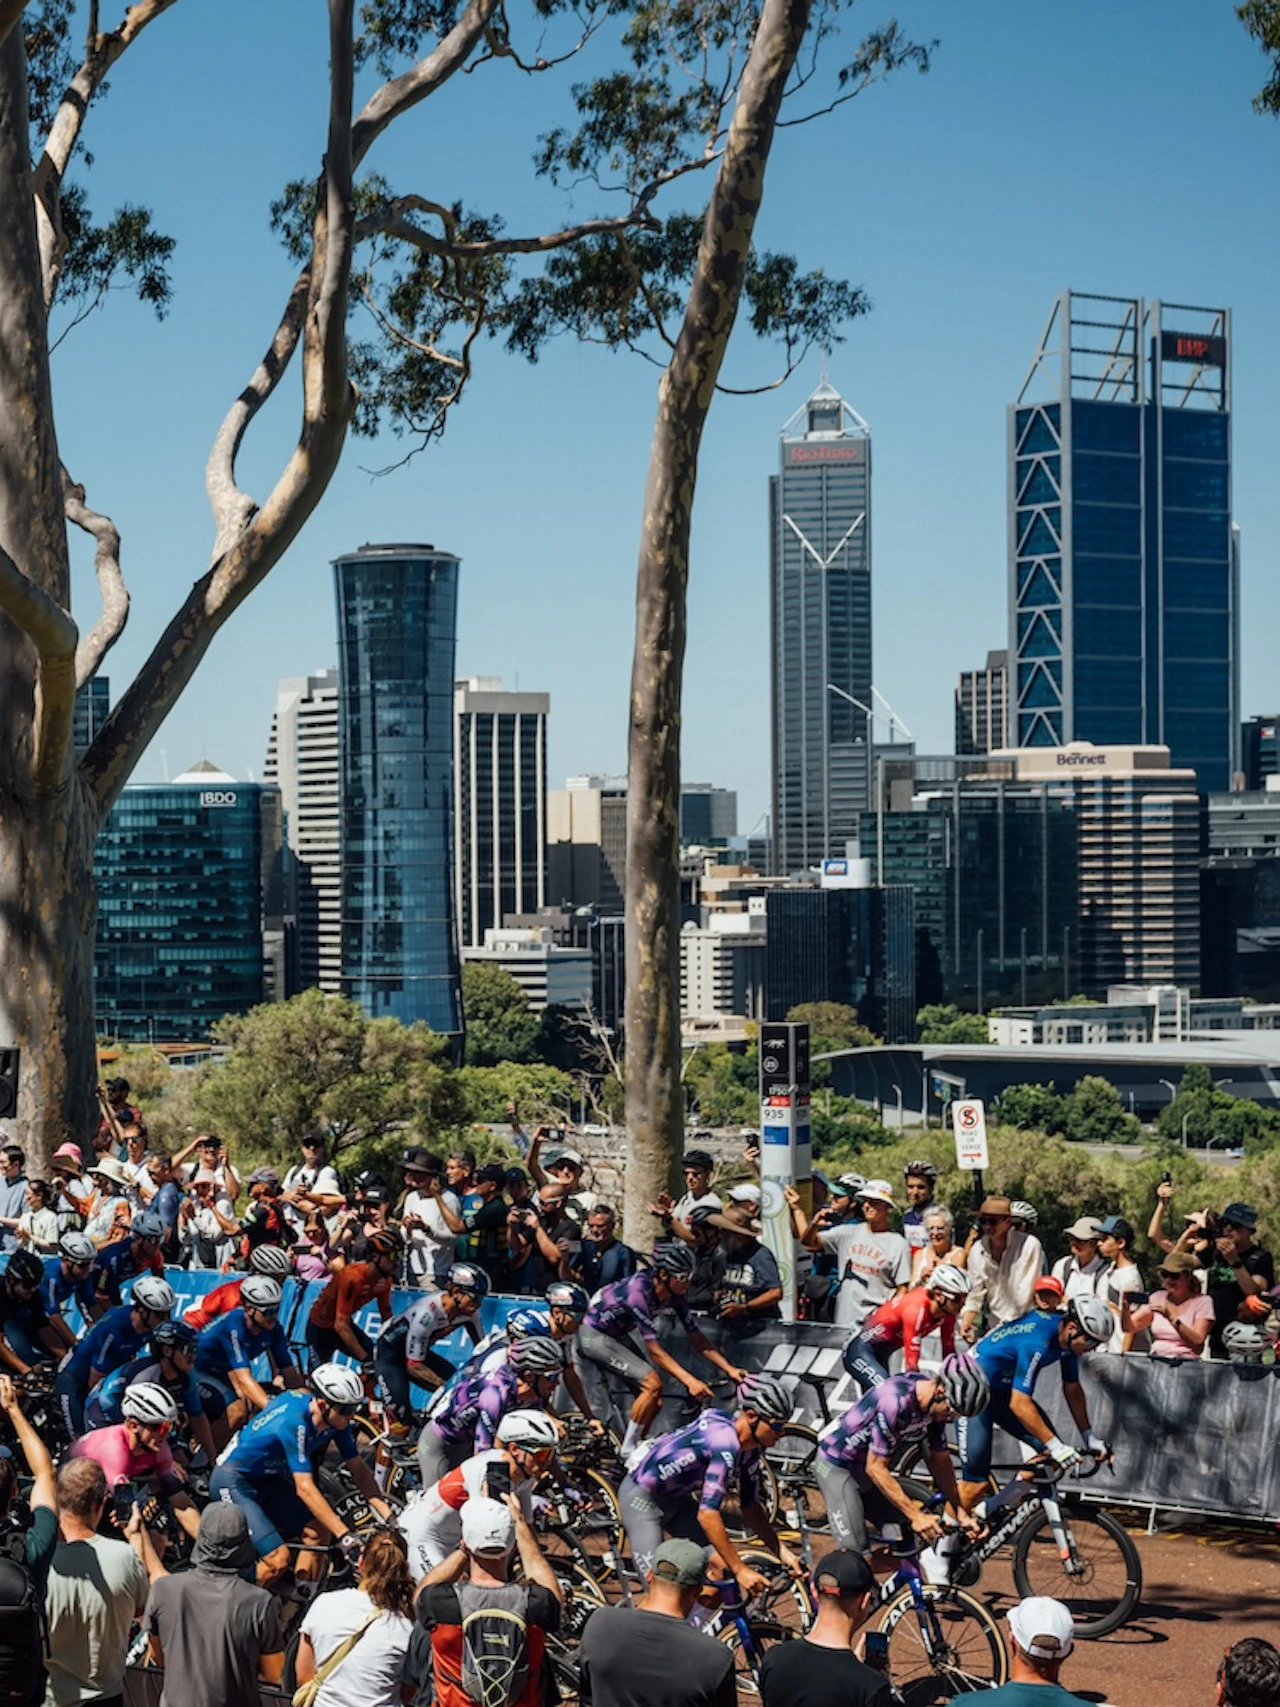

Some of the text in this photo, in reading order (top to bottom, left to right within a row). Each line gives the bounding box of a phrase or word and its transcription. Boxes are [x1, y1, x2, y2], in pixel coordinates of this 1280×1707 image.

[1177, 338, 1208, 357] BHP
[1057, 754, 1106, 766] Bennett
[204, 791, 237, 805] BDO
[764, 1109, 785, 1119] 935
[658, 1452, 697, 1481] Jayco
